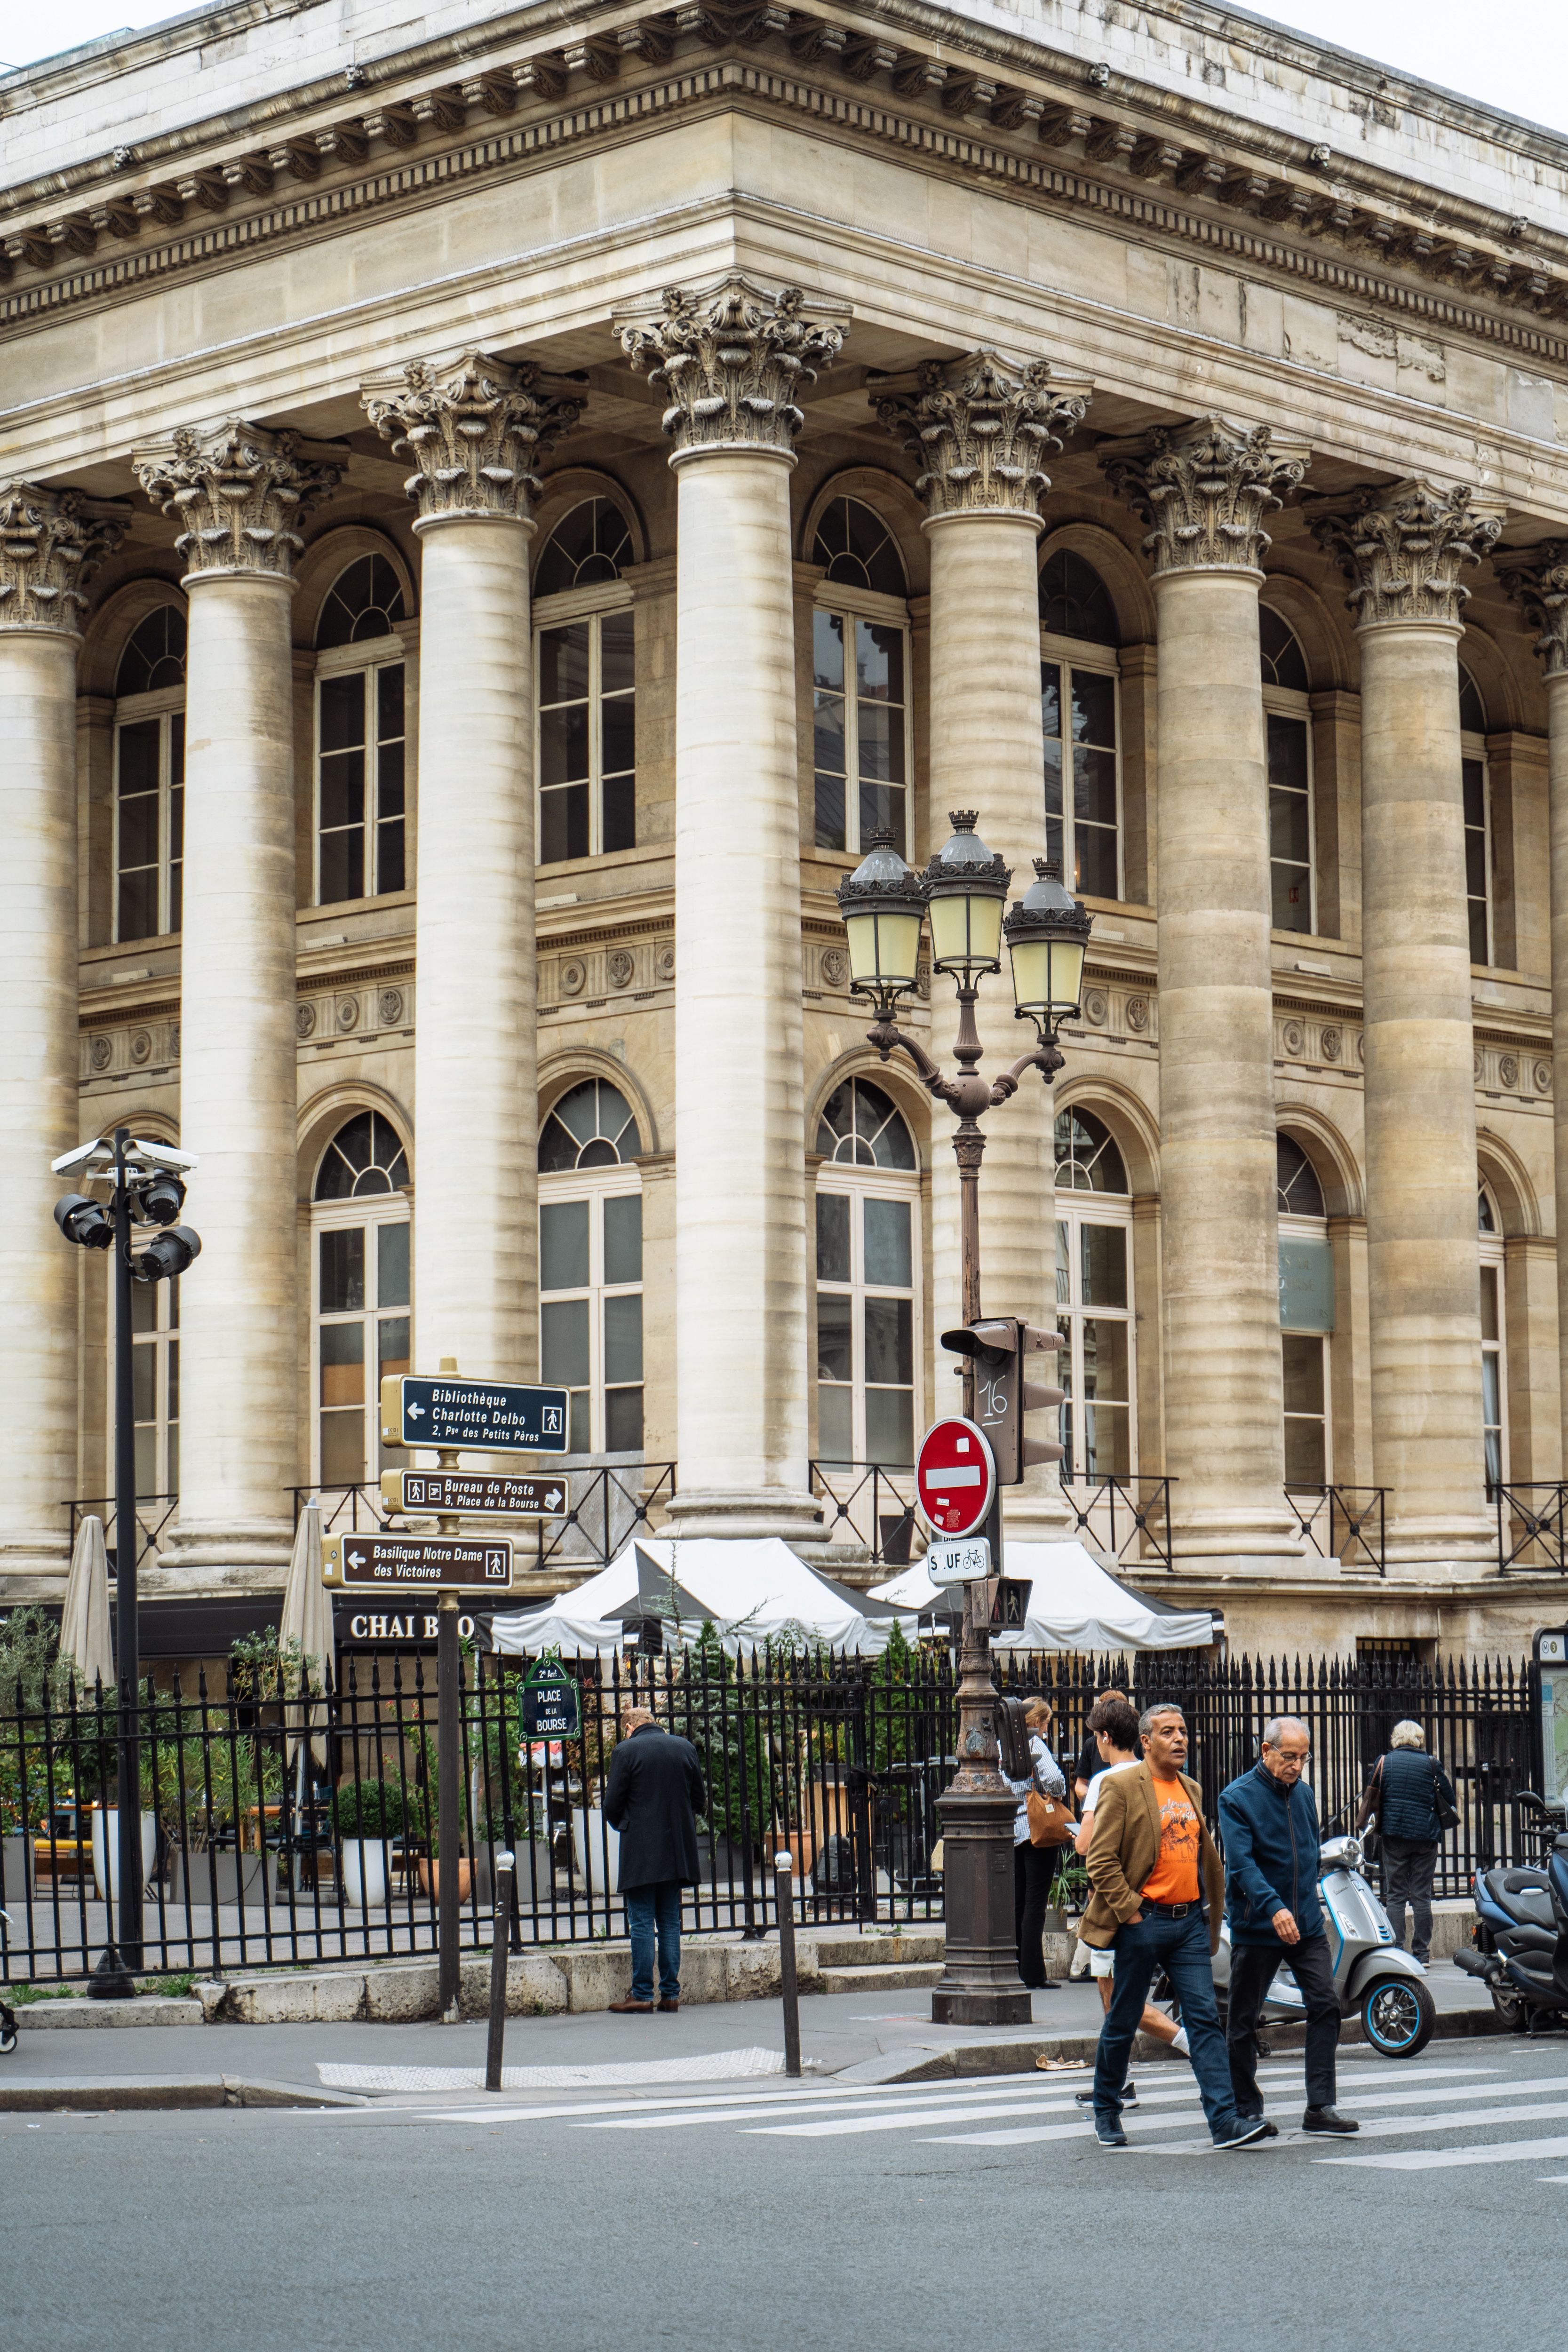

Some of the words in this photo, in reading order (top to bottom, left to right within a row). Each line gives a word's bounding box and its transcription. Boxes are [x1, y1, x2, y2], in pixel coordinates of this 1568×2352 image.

[432, 1390, 506, 1407] Bibliothèque
[433, 1407, 486, 1422] Charlotte
[493, 1412, 525, 1425] Delbo
[432, 1425, 440, 1437] 2,
[463, 1427, 478, 1438] des
[483, 1429, 509, 1439] Petits
[514, 1430, 539, 1441] Pères
[445, 1479, 483, 1493] Bureau
[487, 1481, 499, 1494] de
[504, 1482, 533, 1495] Poste
[445, 1495, 453, 1506] 8,
[457, 1495, 480, 1506] Place
[485, 1497, 494, 1507] de
[498, 1497, 506, 1507] la
[509, 1498, 539, 1509] Bourse
[374, 1546, 420, 1562] Basilique
[423, 1547, 451, 1560] Notre
[454, 1548, 482, 1561] Dame
[931, 1553, 961, 1571] SUF
[374, 1564, 392, 1576] des
[397, 1565, 441, 1578] Victoires
[350, 1615, 415, 1638] CHAI
[423, 1616, 475, 1638] BO
[537, 1690, 562, 1703] PLACE
[537, 1718, 567, 1732] BOURSE
